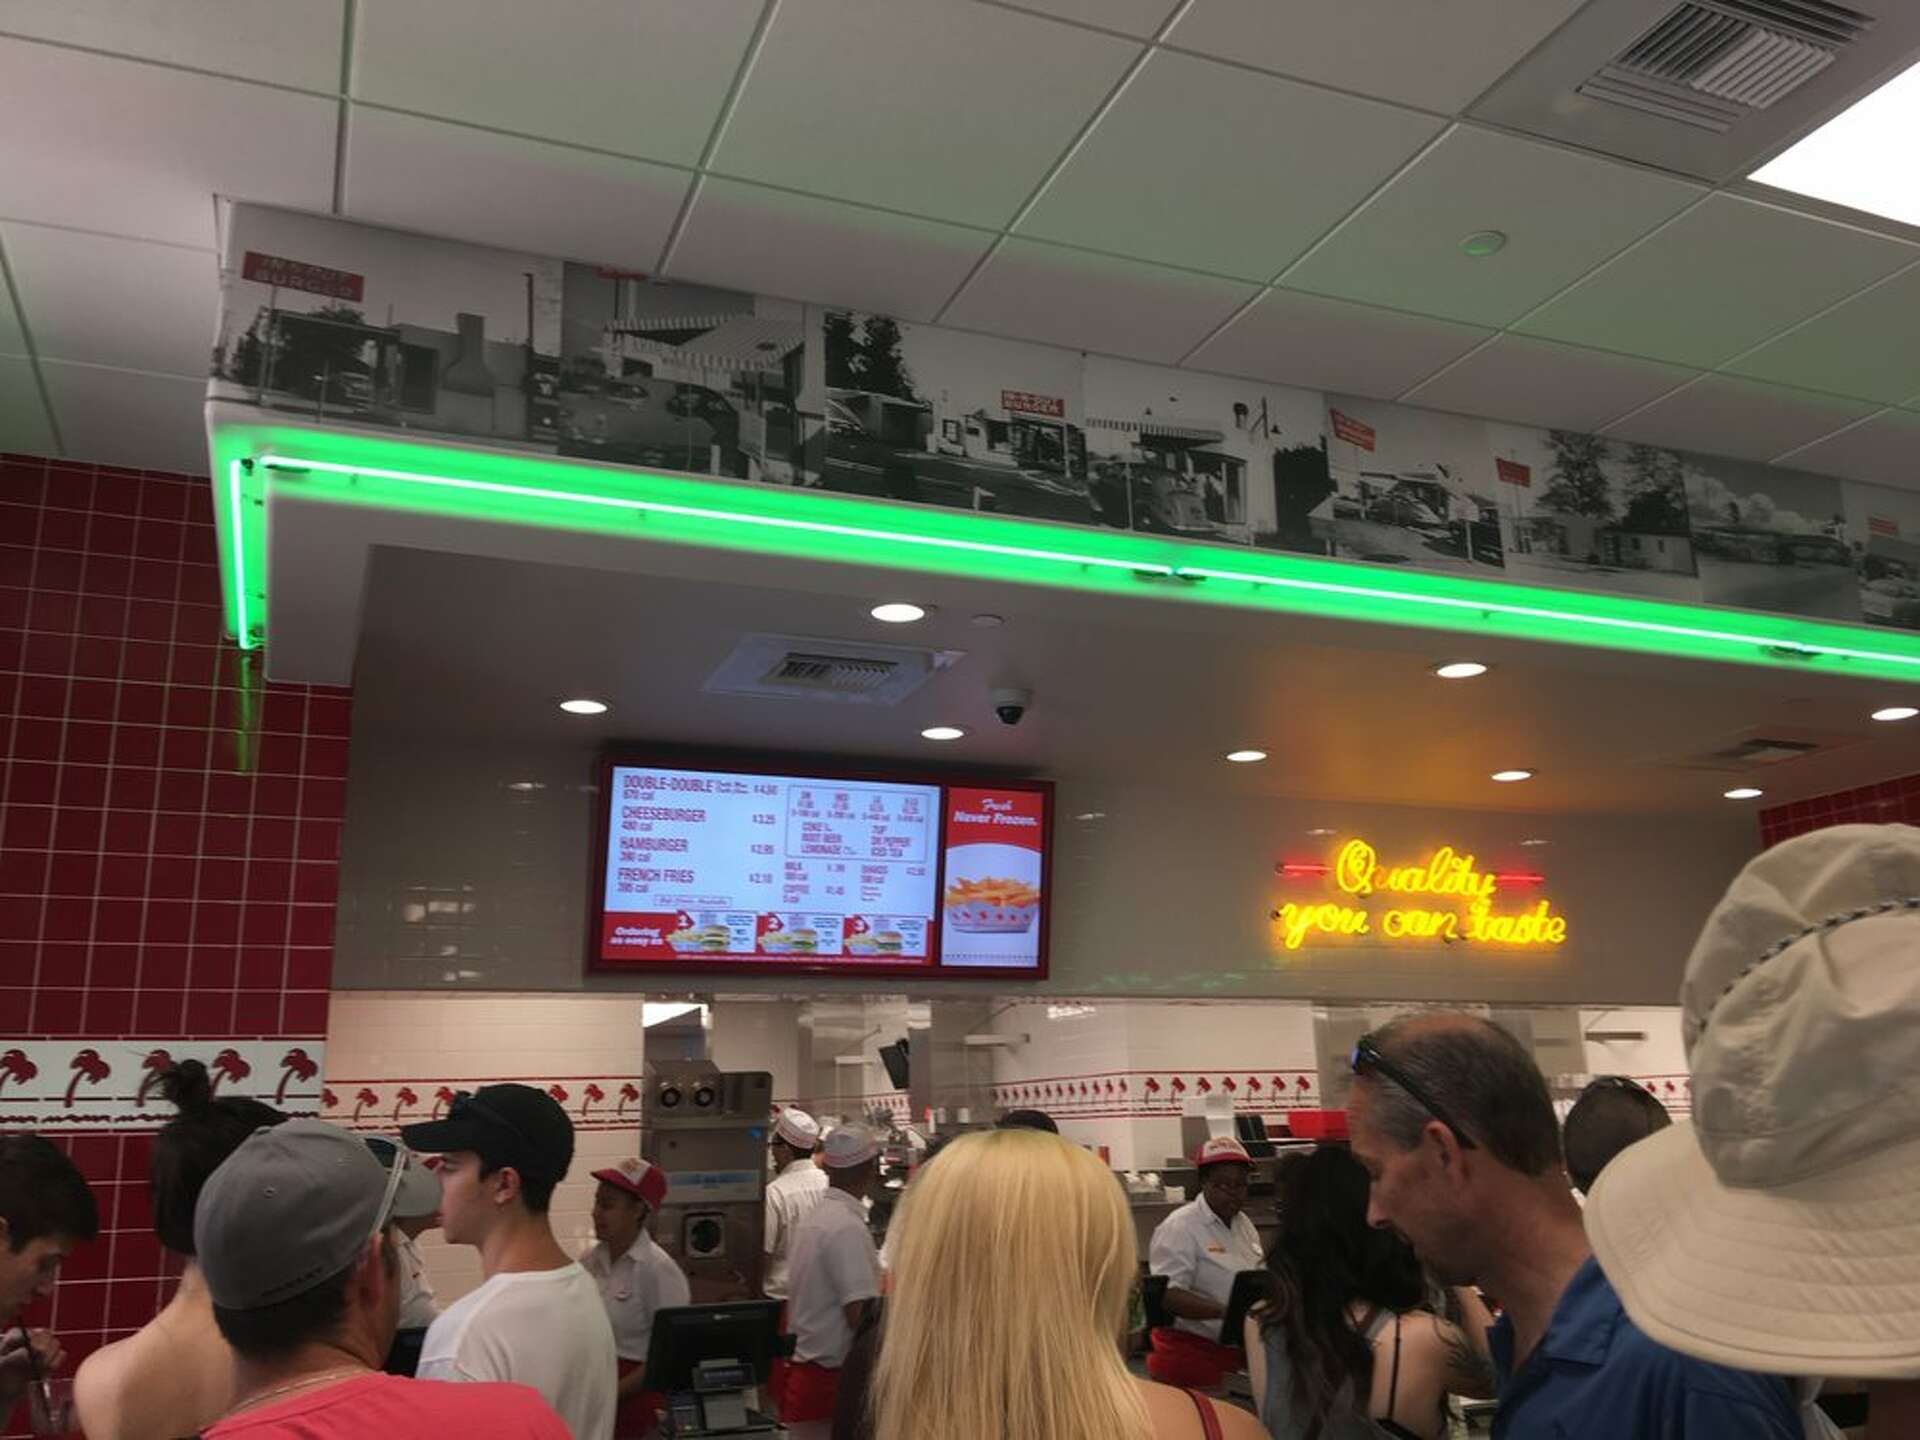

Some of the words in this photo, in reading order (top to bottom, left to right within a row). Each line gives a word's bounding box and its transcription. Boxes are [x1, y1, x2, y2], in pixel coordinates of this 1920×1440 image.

[623, 775, 713, 793] DOUBLE-DOUBLE
[621, 805, 706, 822] CHEESEBURGER
[953, 810, 992, 823] Never
[619, 837, 688, 852] HAMBURGER
[617, 867, 661, 882] FRENCH
[664, 869, 694, 884] FRIES
[1335, 838, 1497, 898] Quality
[615, 926, 661, 938] Ordering
[1278, 902, 1370, 950] you
[1382, 909, 1458, 939] can
[1464, 897, 1567, 944] taste
[625, 938, 648, 947] easy
